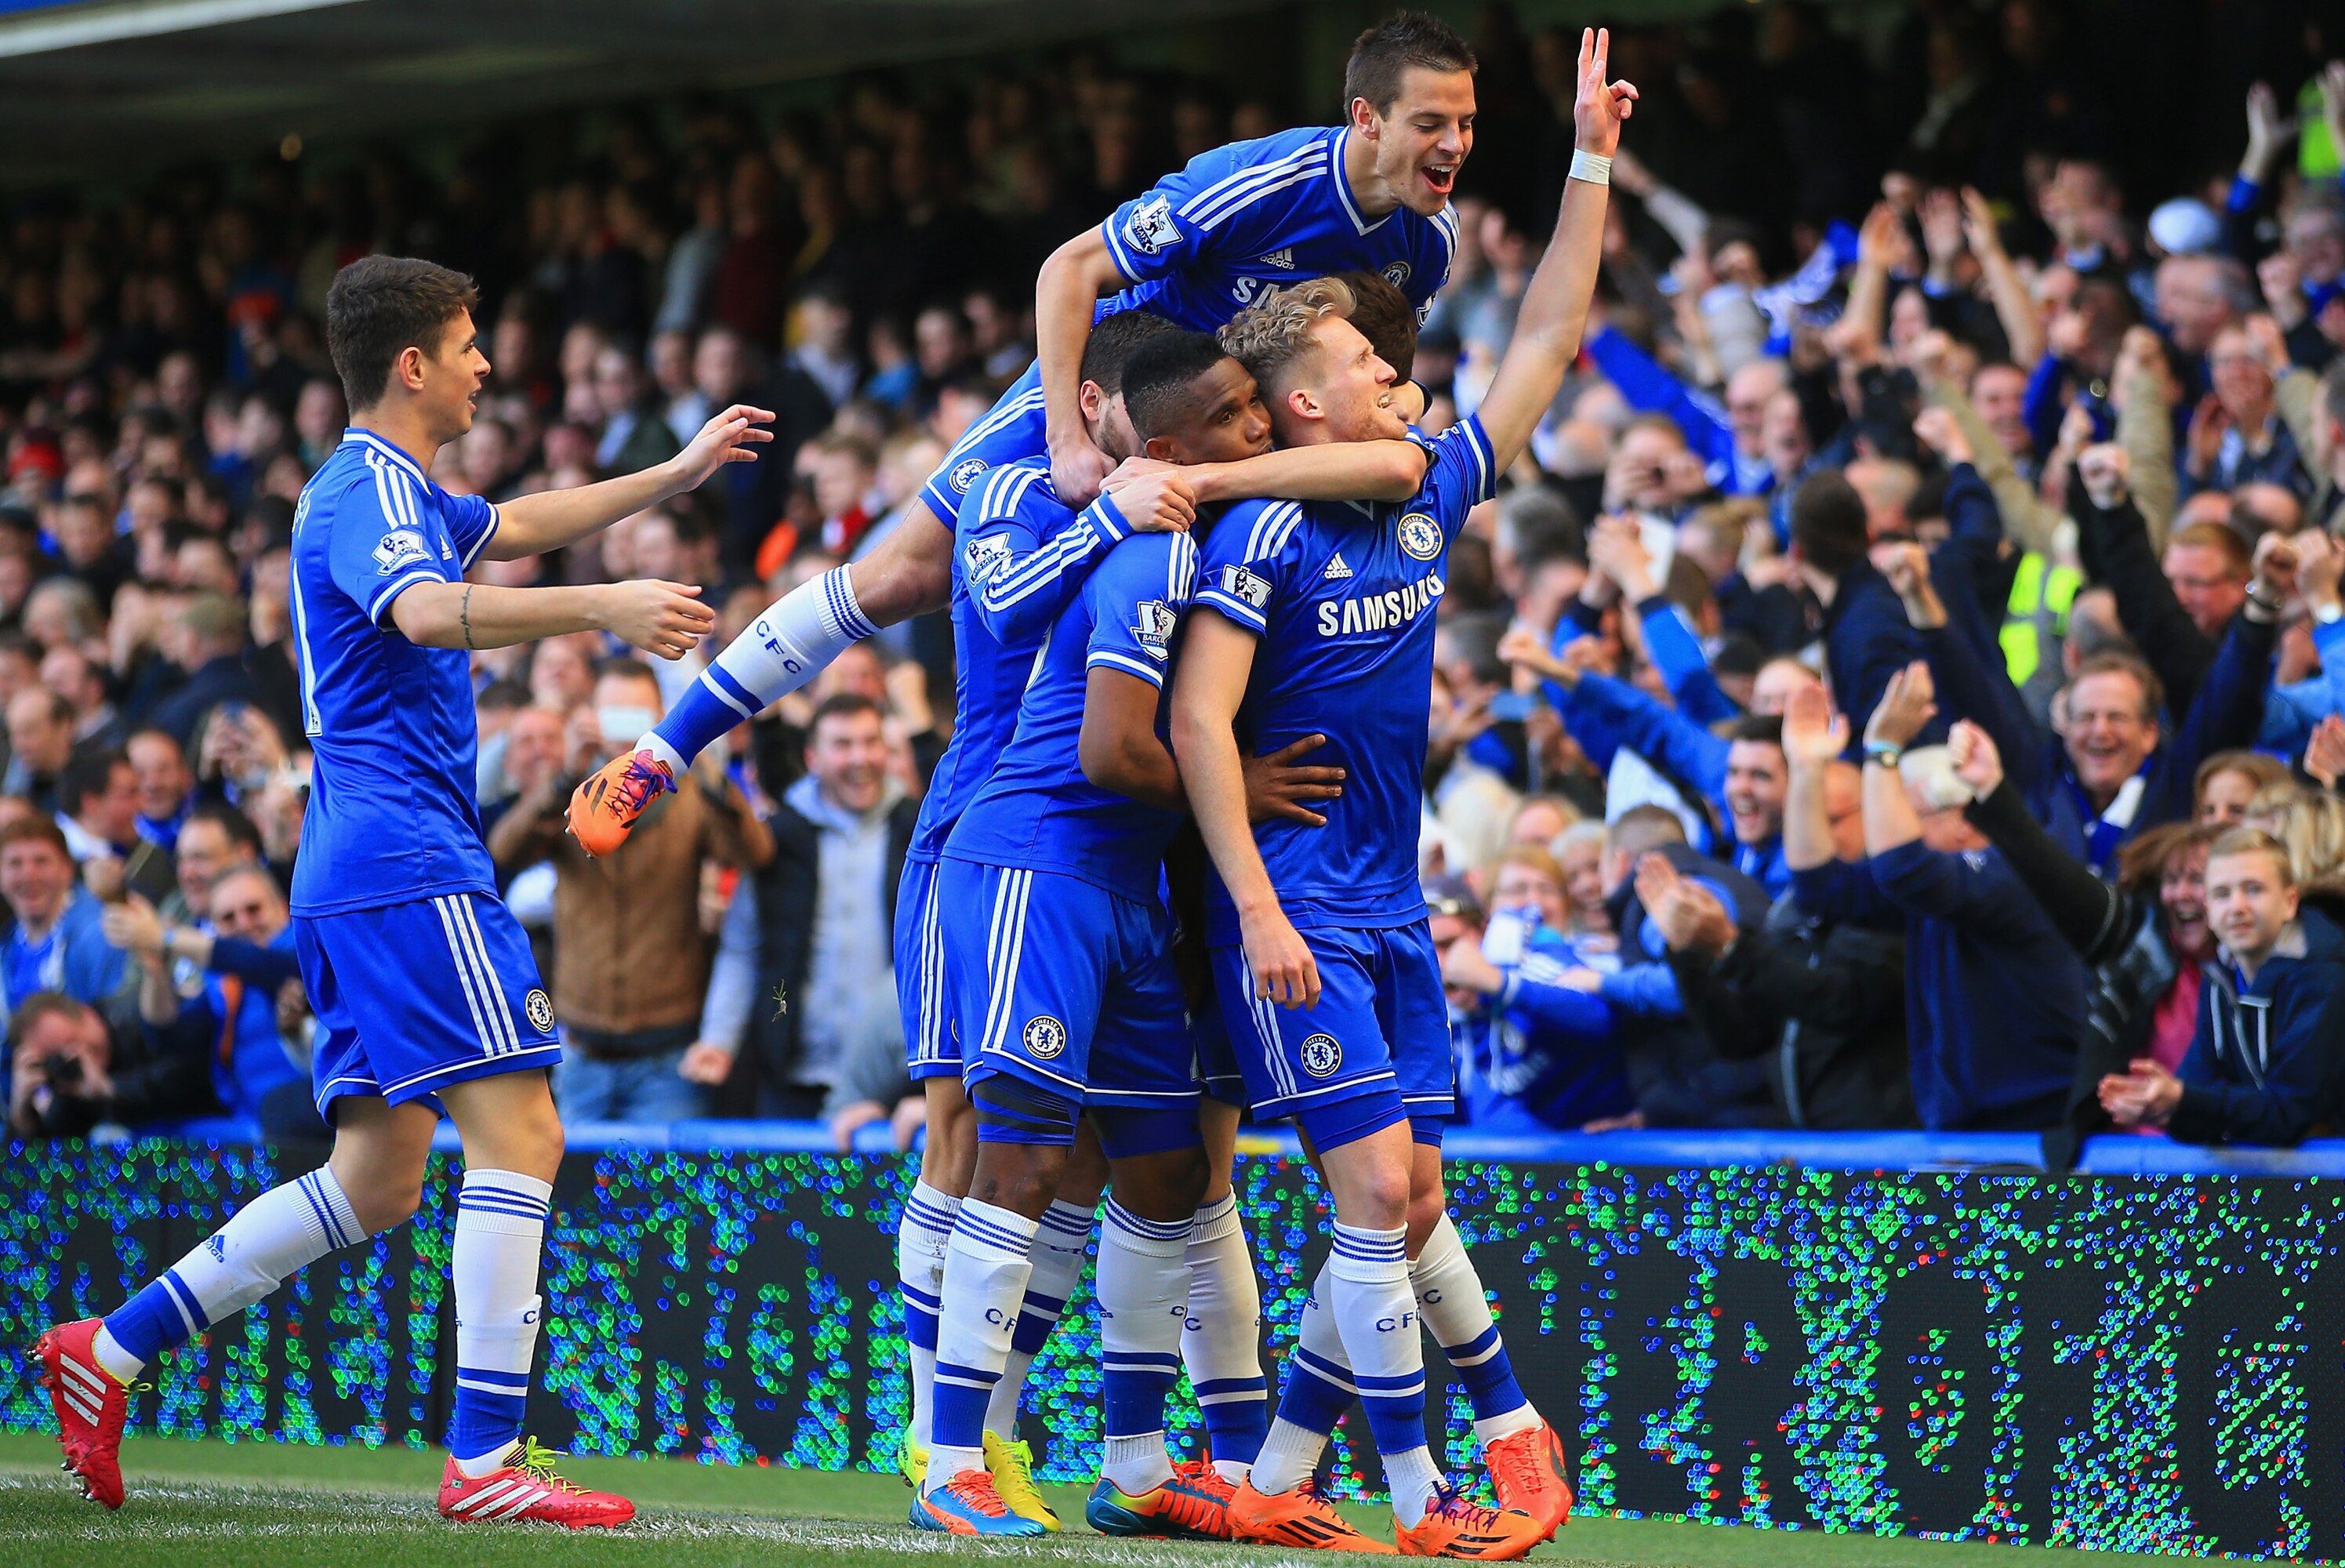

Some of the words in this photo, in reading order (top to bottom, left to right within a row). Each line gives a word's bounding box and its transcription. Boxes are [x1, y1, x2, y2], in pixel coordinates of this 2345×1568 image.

[1260, 256, 1295, 270] adidas
[1324, 568, 1354, 579] adidas
[1318, 568, 1445, 637] SAMSUNG
[757, 620, 801, 674] CFC
[1033, 1019, 1060, 1031] CHELSEA
[1305, 1036, 1330, 1048] CHELSEA
